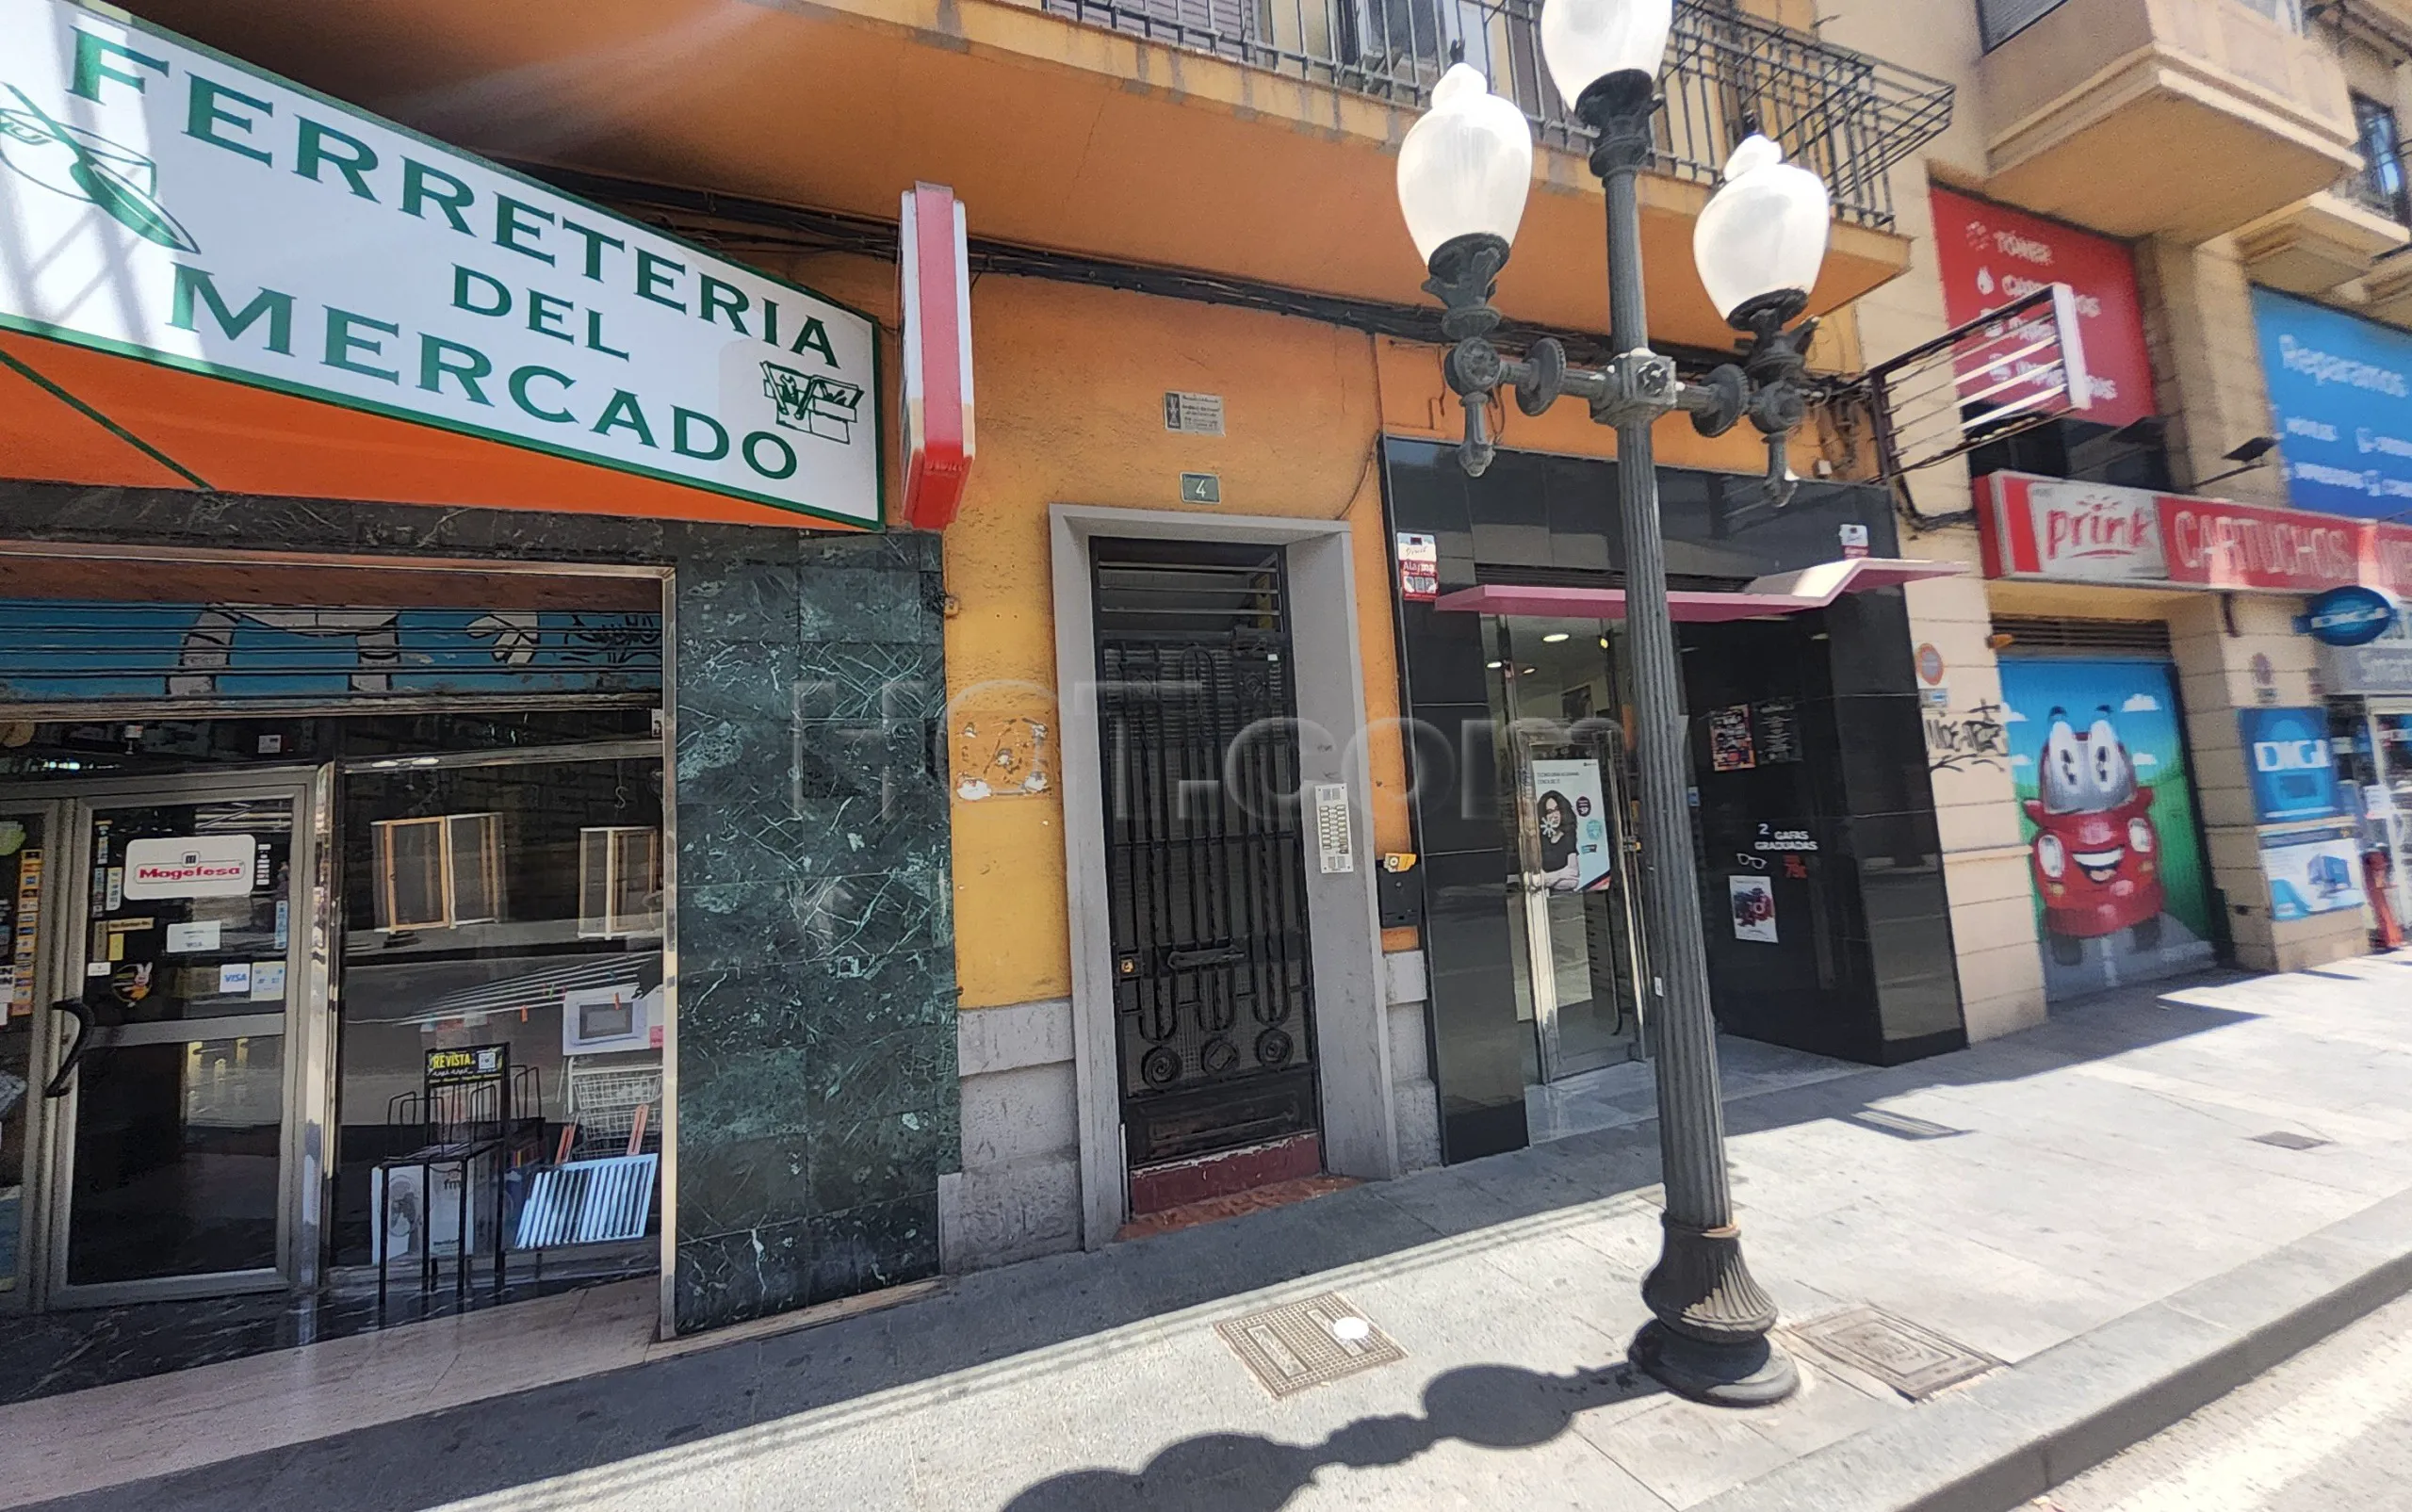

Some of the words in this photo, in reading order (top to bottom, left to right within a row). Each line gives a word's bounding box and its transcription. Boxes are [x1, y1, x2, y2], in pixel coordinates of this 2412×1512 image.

[65, 25, 841, 369] FERRETERIA
[450, 263, 630, 362] DEL
[165, 262, 799, 480] MERCADO
[1195, 479, 1207, 497] 4
[2174, 510, 2357, 580] CARTUCHOS
[2253, 739, 2331, 772] DIGI
[1758, 822, 1770, 836] 2
[139, 866, 241, 880] Magefesa
[223, 972, 247, 983] VISA
